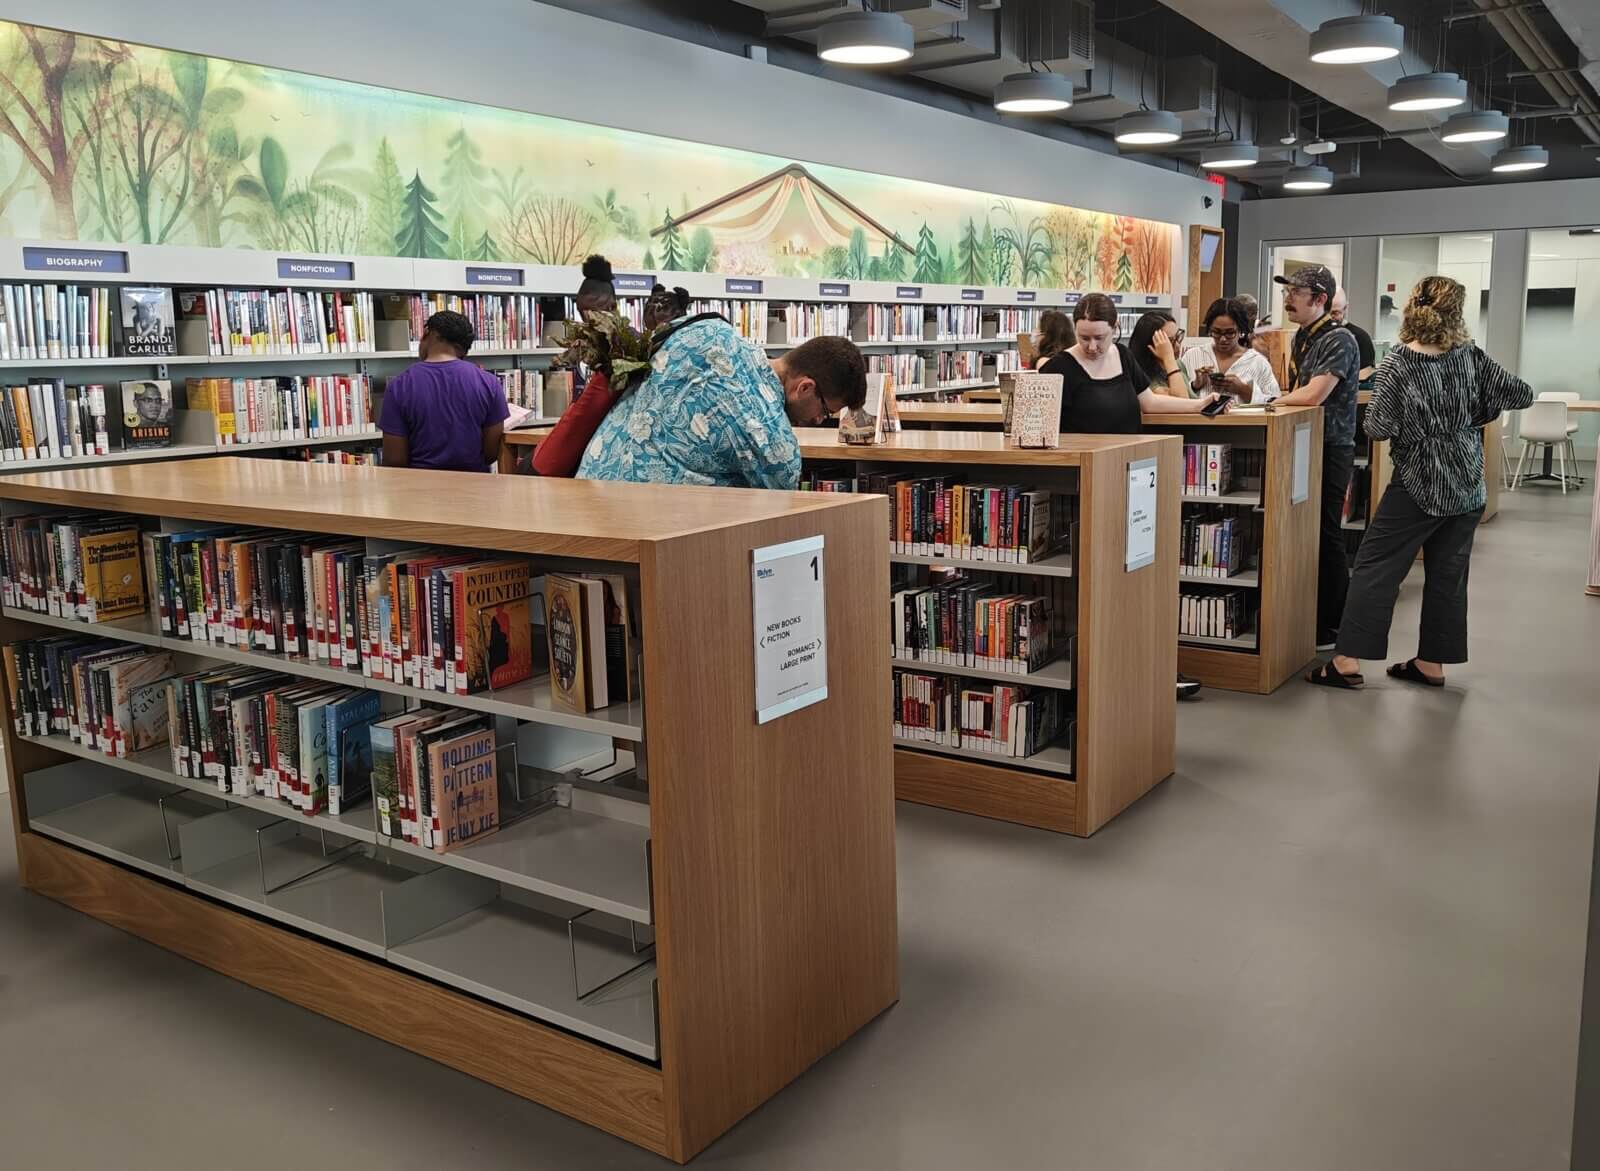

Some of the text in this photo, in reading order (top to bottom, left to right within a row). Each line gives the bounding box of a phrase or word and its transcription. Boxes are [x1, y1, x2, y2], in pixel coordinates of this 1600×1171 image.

[46, 257, 104, 267] BIOGRAPHY
[290, 264, 336, 273] NONFICTION
[129, 335, 172, 344] BRANDI
[128, 344, 174, 353] CARLILE
[131, 427, 170, 438] ARISING
[1149, 471, 1155, 488] 2
[467, 566, 529, 587] IN THE UPPER
[810, 556, 818, 581] 1
[467, 582, 529, 607] COUNTRY
[767, 616, 801, 633] NEW BOOKS
[767, 630, 791, 643] FICTION
[787, 642, 815, 657] ROMANCE
[780, 652, 816, 671] LARGE PRINT
[127, 689, 166, 720] Favo
[442, 738, 492, 769] HOLDING
[443, 760, 493, 793] PATTERN
